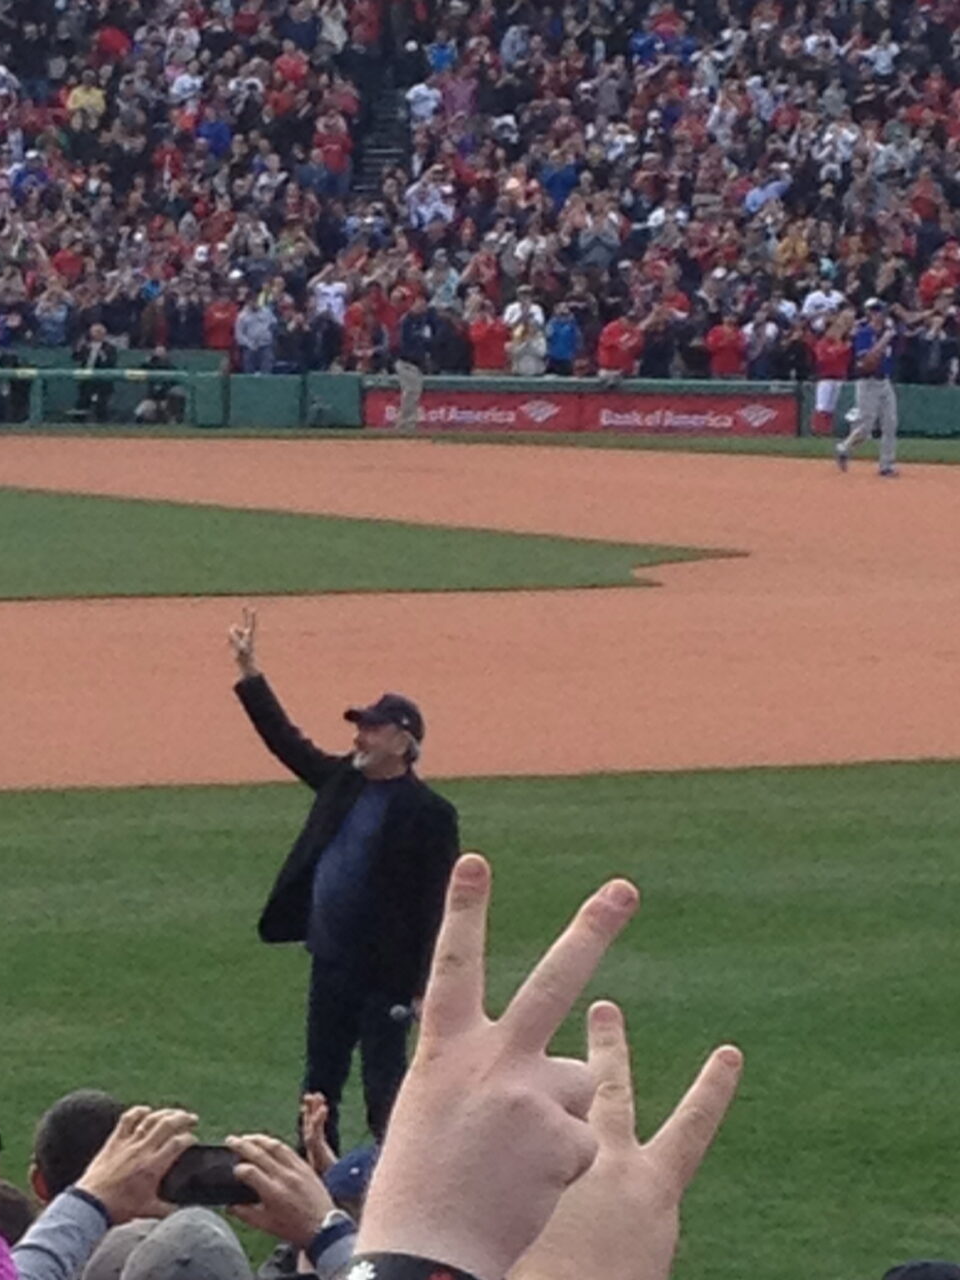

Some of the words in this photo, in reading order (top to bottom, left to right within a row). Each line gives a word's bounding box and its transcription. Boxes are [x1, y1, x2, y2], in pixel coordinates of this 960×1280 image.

[428, 406, 445, 421] of
[447, 406, 516, 423] America
[600, 408, 643, 426] Bank
[644, 408, 662, 426] of
[663, 408, 733, 428] America
